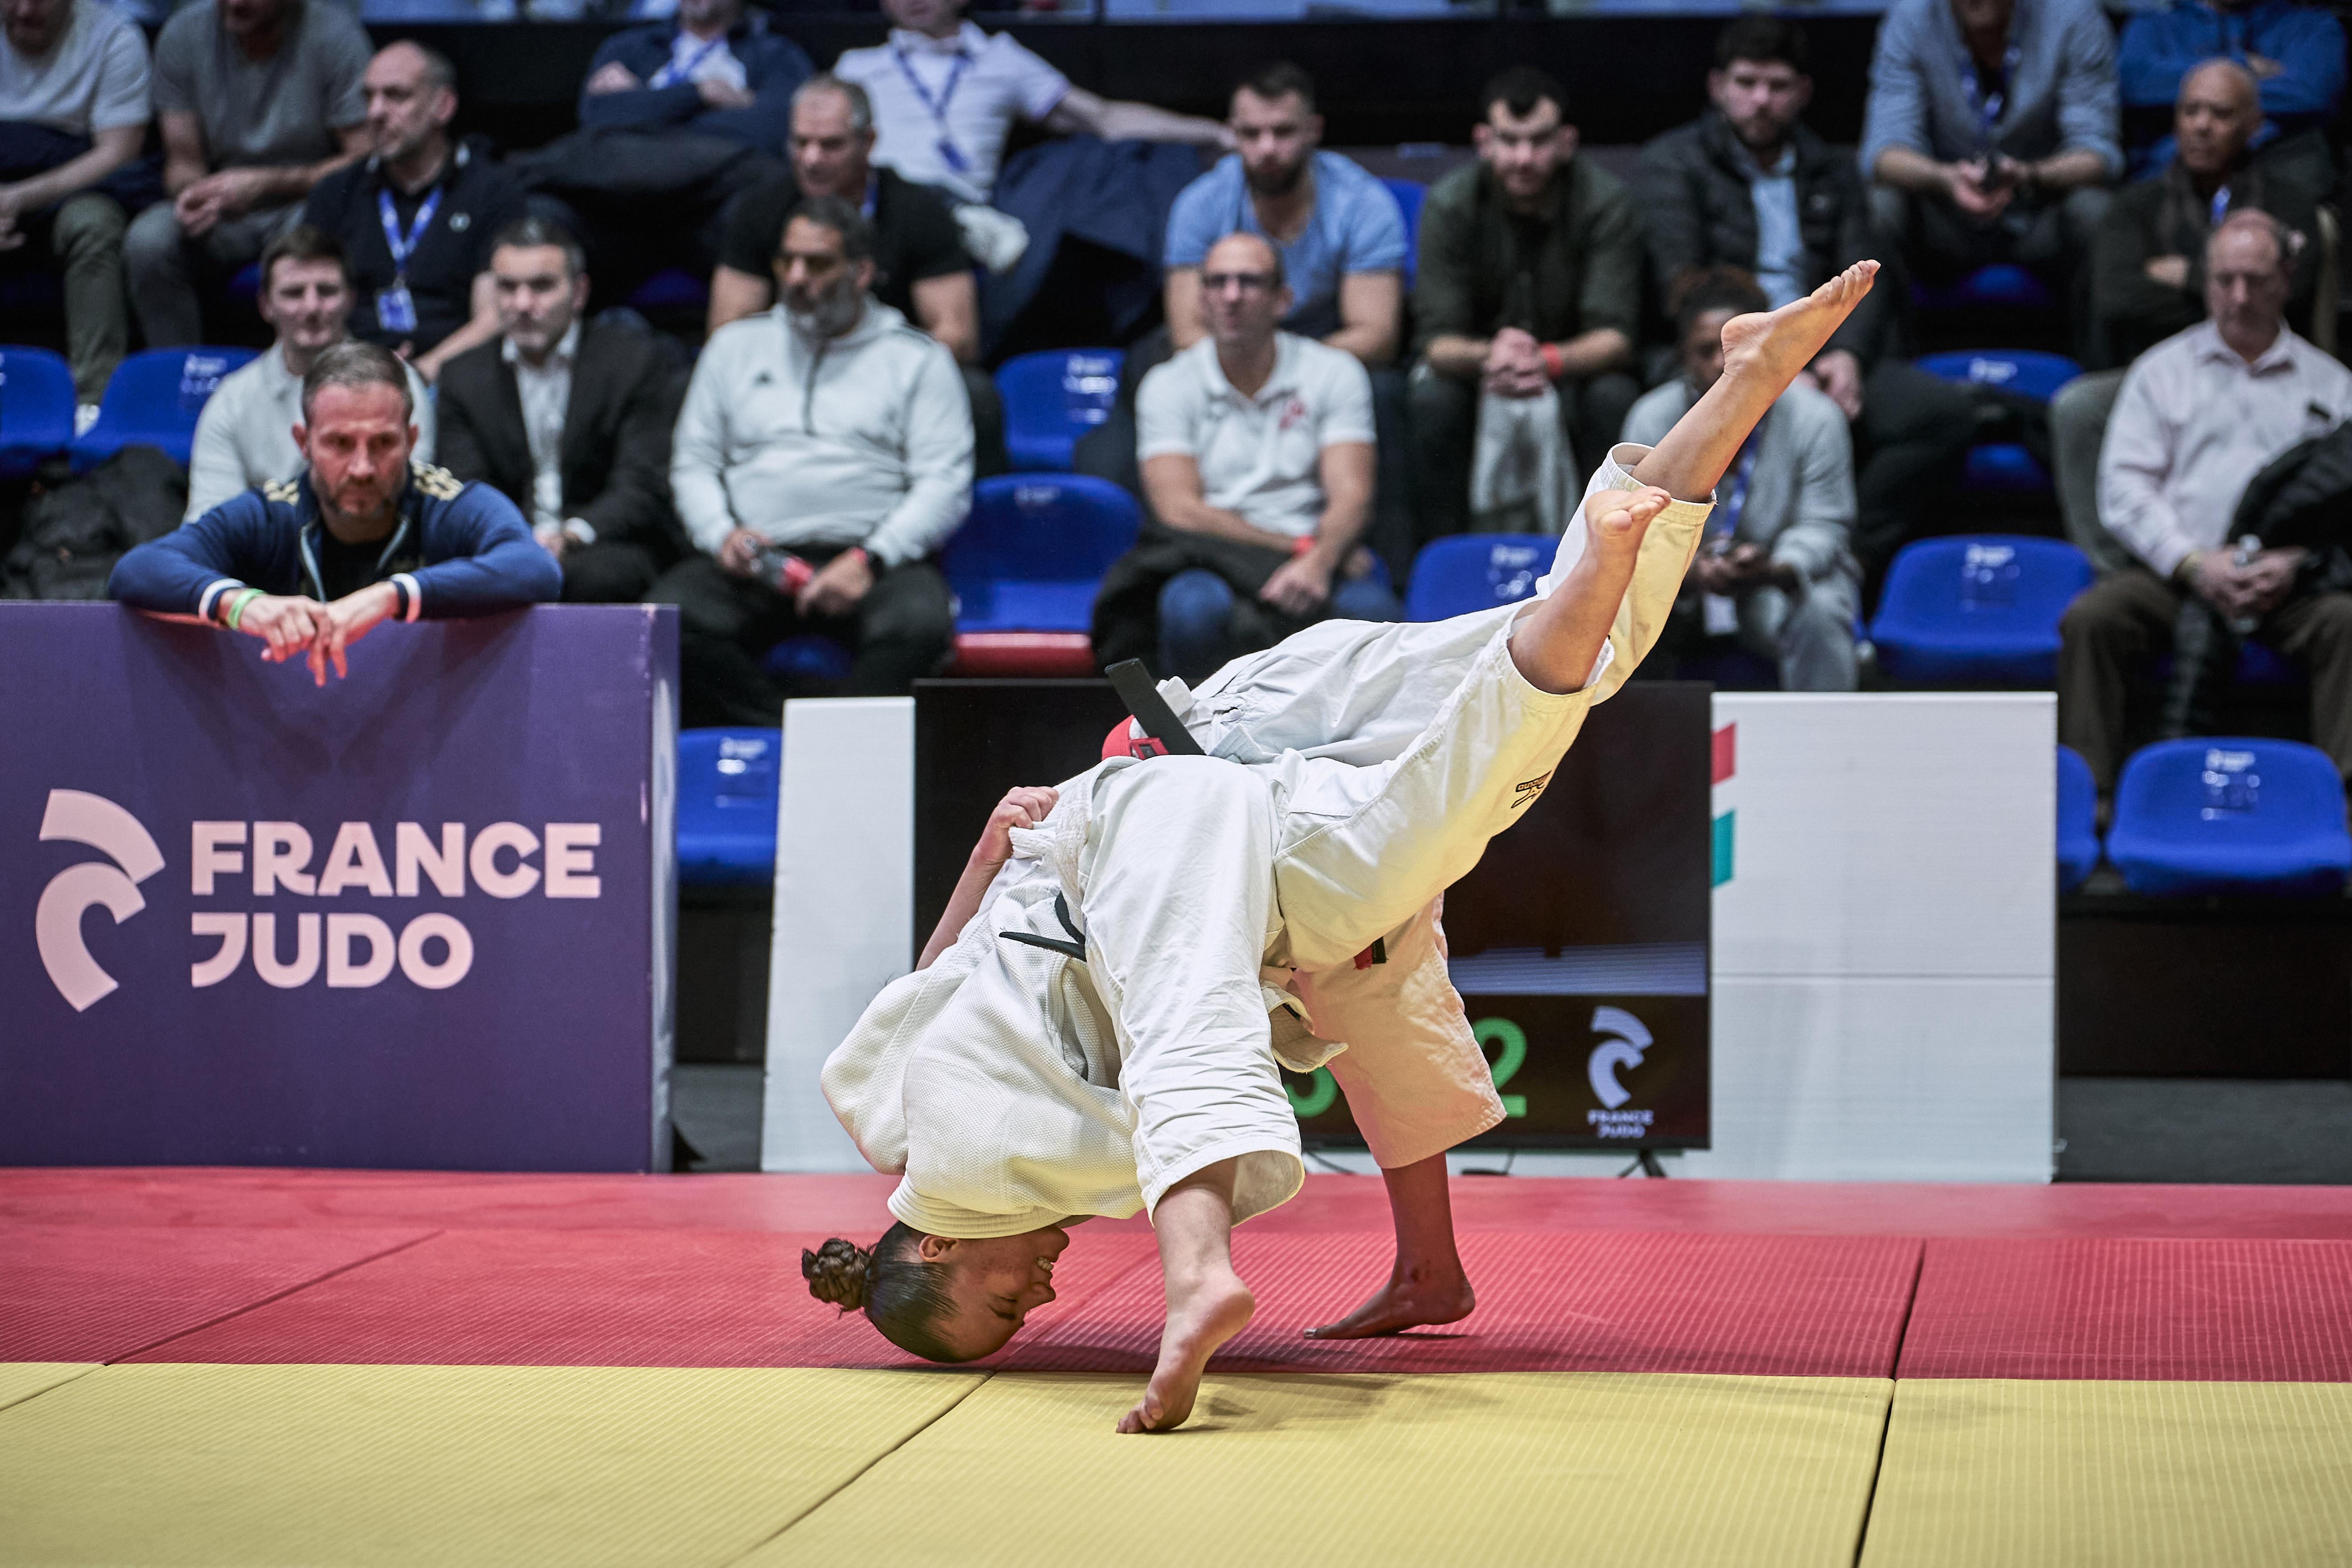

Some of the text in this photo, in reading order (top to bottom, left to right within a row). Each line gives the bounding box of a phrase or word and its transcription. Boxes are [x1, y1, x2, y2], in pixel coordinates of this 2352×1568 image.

[192, 821, 602, 898] FRANCE
[192, 913, 474, 989] JUDO
[1588, 1110, 1654, 1125] FRANCE
[1598, 1125, 1646, 1138] JUDO
